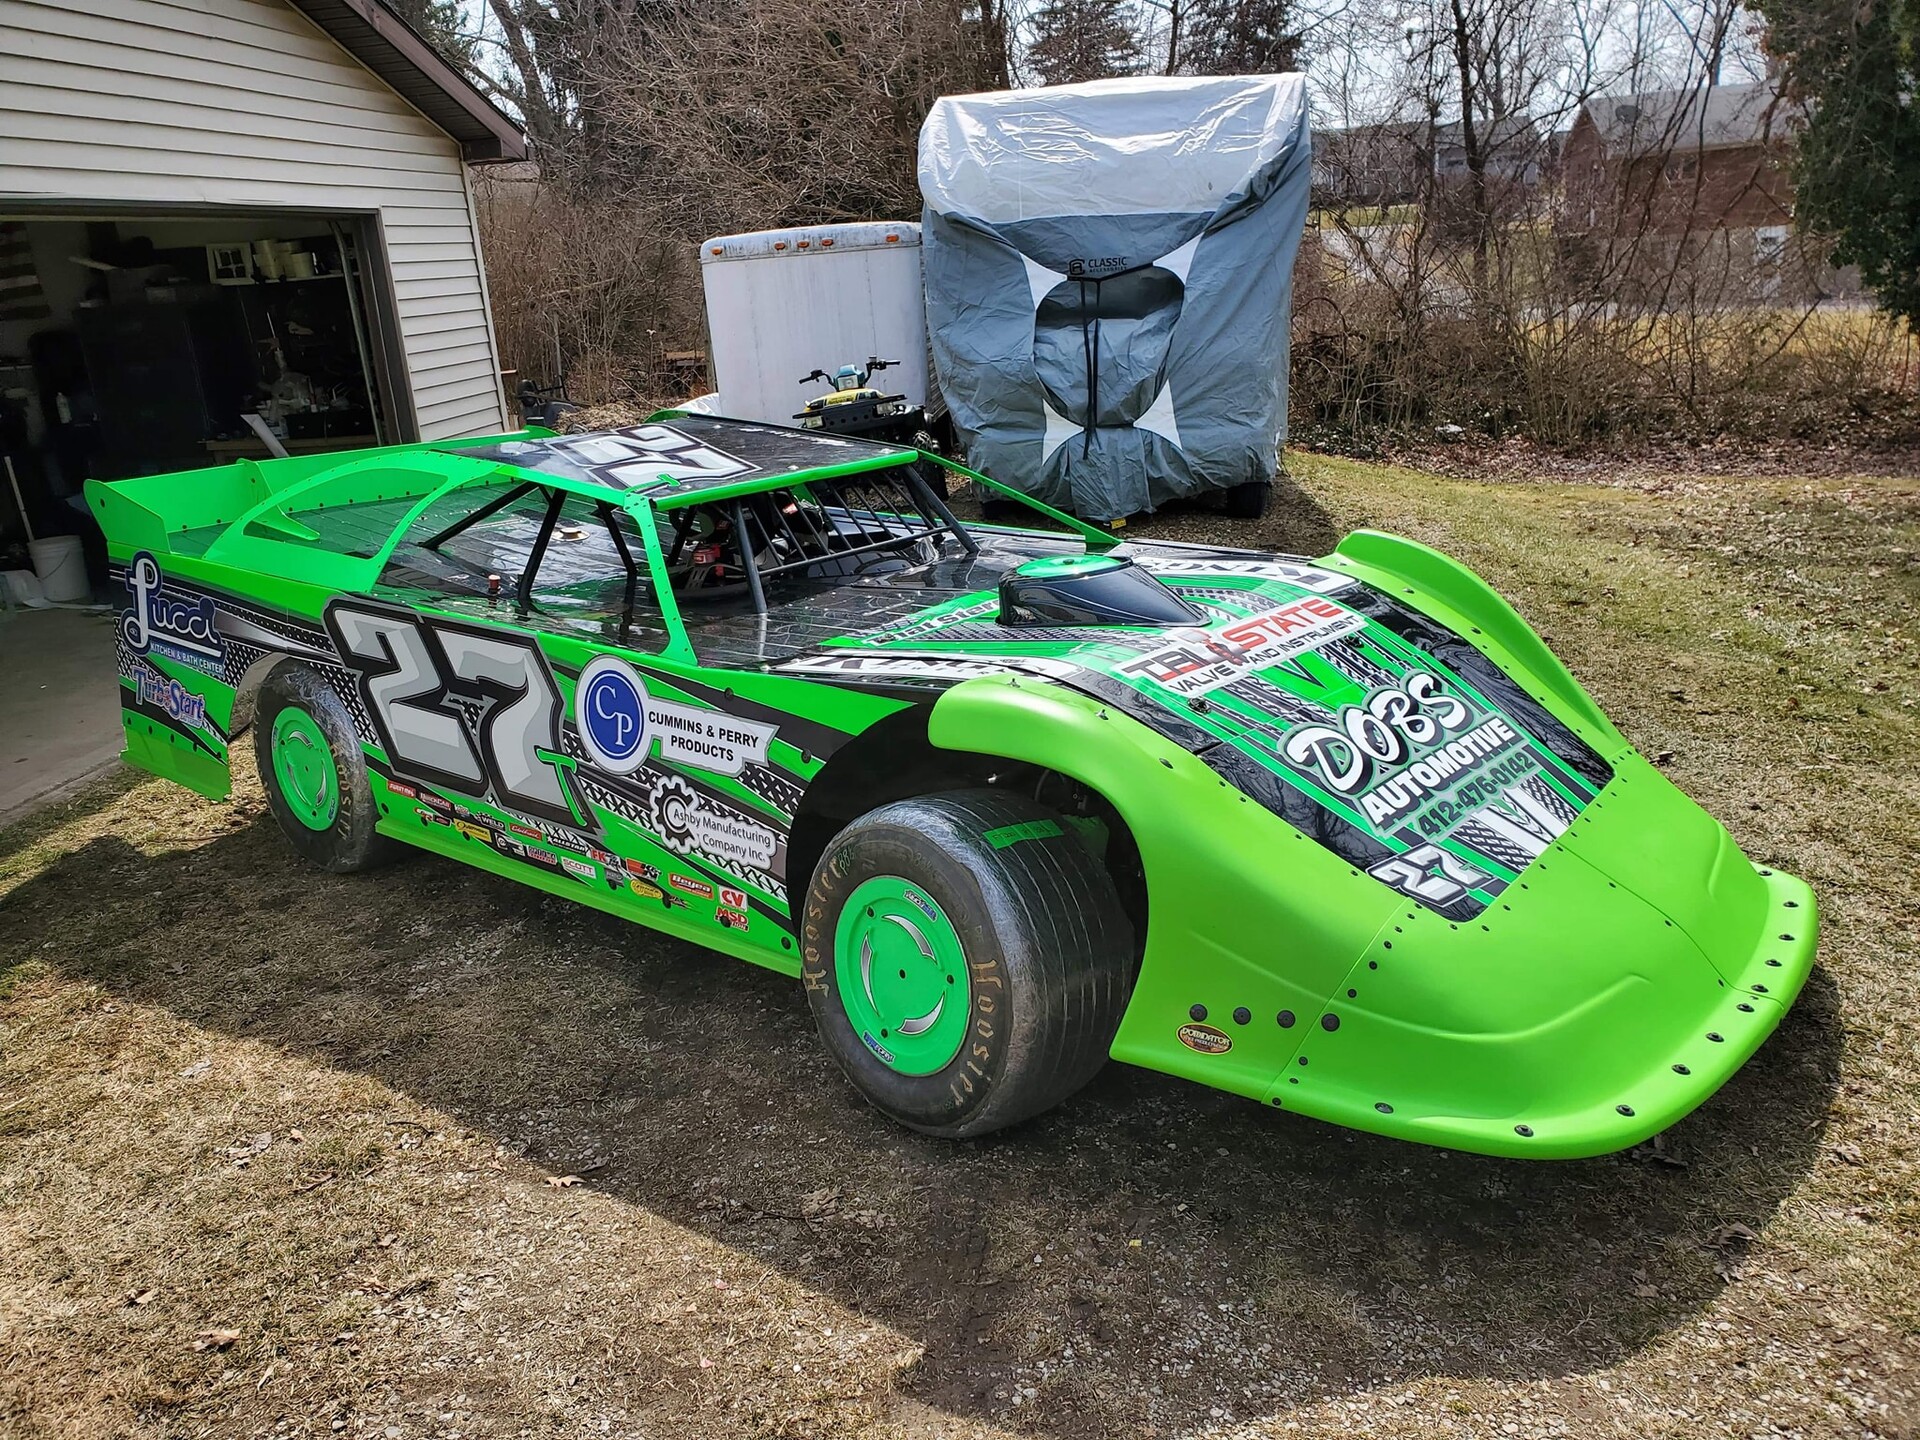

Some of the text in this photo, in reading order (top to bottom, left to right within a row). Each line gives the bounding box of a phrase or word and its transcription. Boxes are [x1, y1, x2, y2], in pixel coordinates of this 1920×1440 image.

[1088, 257, 1127, 268] CLASSIC
[1222, 599, 1344, 650] STATE
[150, 642, 176, 658] KITCHEN
[183, 653, 198, 666] BATH
[200, 657, 224, 674] CENTER
[1168, 615, 1360, 693] VALVE AND INSTRUMENT
[649, 711, 759, 748] CUMMINS & PERRY
[671, 735, 734, 762] PRODUCTS
[1360, 717, 1516, 826] AUTOMOTIVE
[1418, 751, 1536, 838] 412-476-0142
[482, 817, 504, 829] WELD
[674, 808, 771, 847] Ashby Manufacturing
[703, 834, 765, 862] Company Inc.
[563, 858, 593, 872] SCOTT
[672, 875, 710, 893] Beyea
[721, 889, 744, 907] CV
[717, 907, 747, 925] MSD
